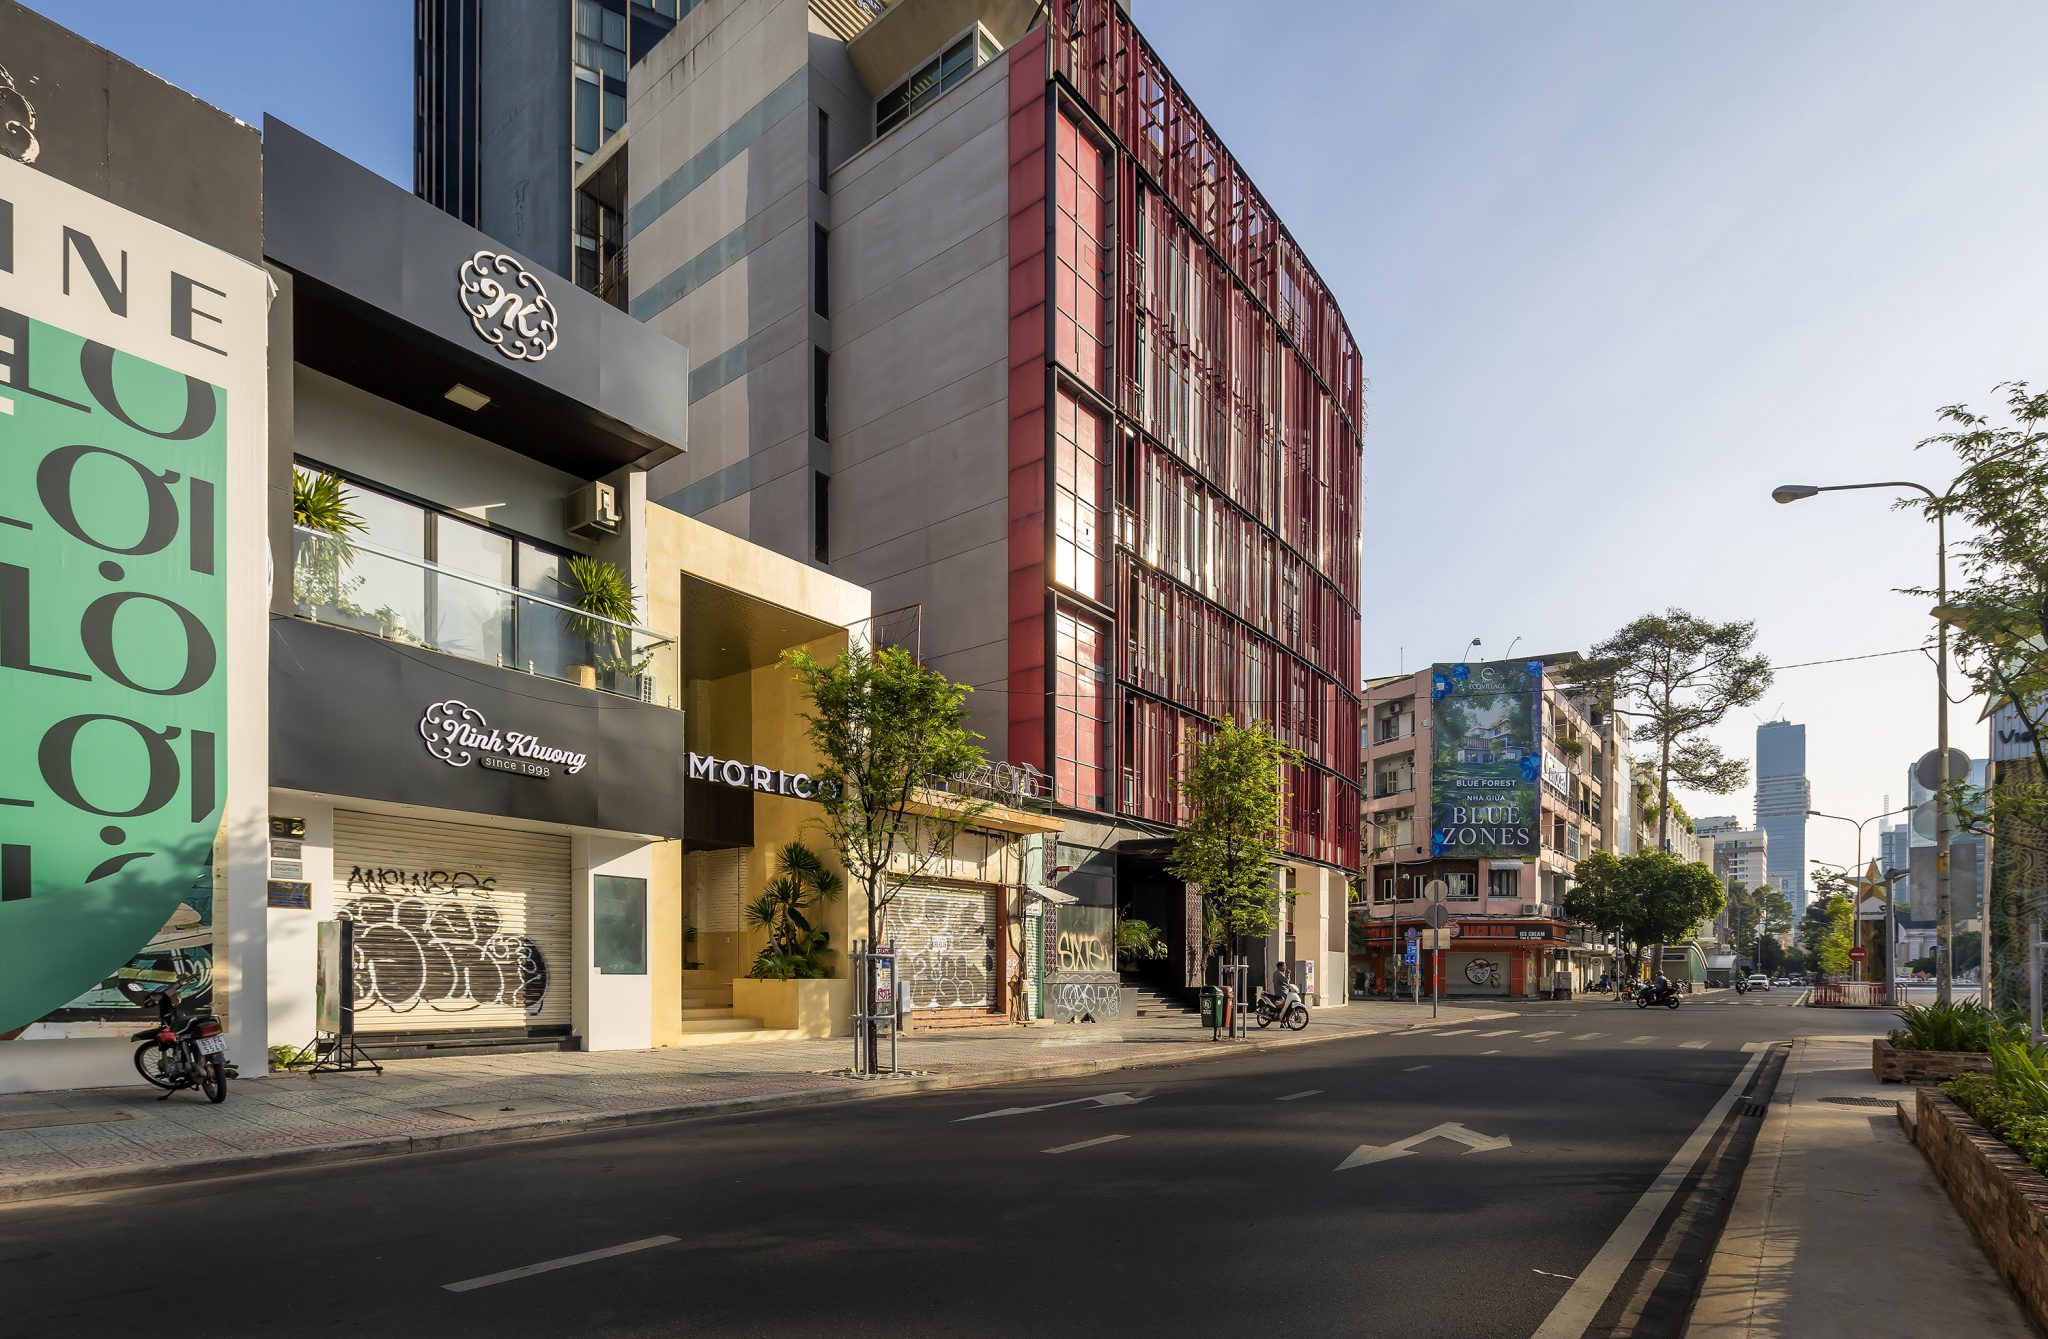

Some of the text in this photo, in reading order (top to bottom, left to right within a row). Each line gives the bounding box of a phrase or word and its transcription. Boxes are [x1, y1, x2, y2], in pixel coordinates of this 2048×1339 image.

[442, 719, 504, 752] Ninh
[485, 757, 551, 778] since 1998
[1452, 806, 1521, 825] BLUE
[1442, 827, 1530, 846] ZONES
